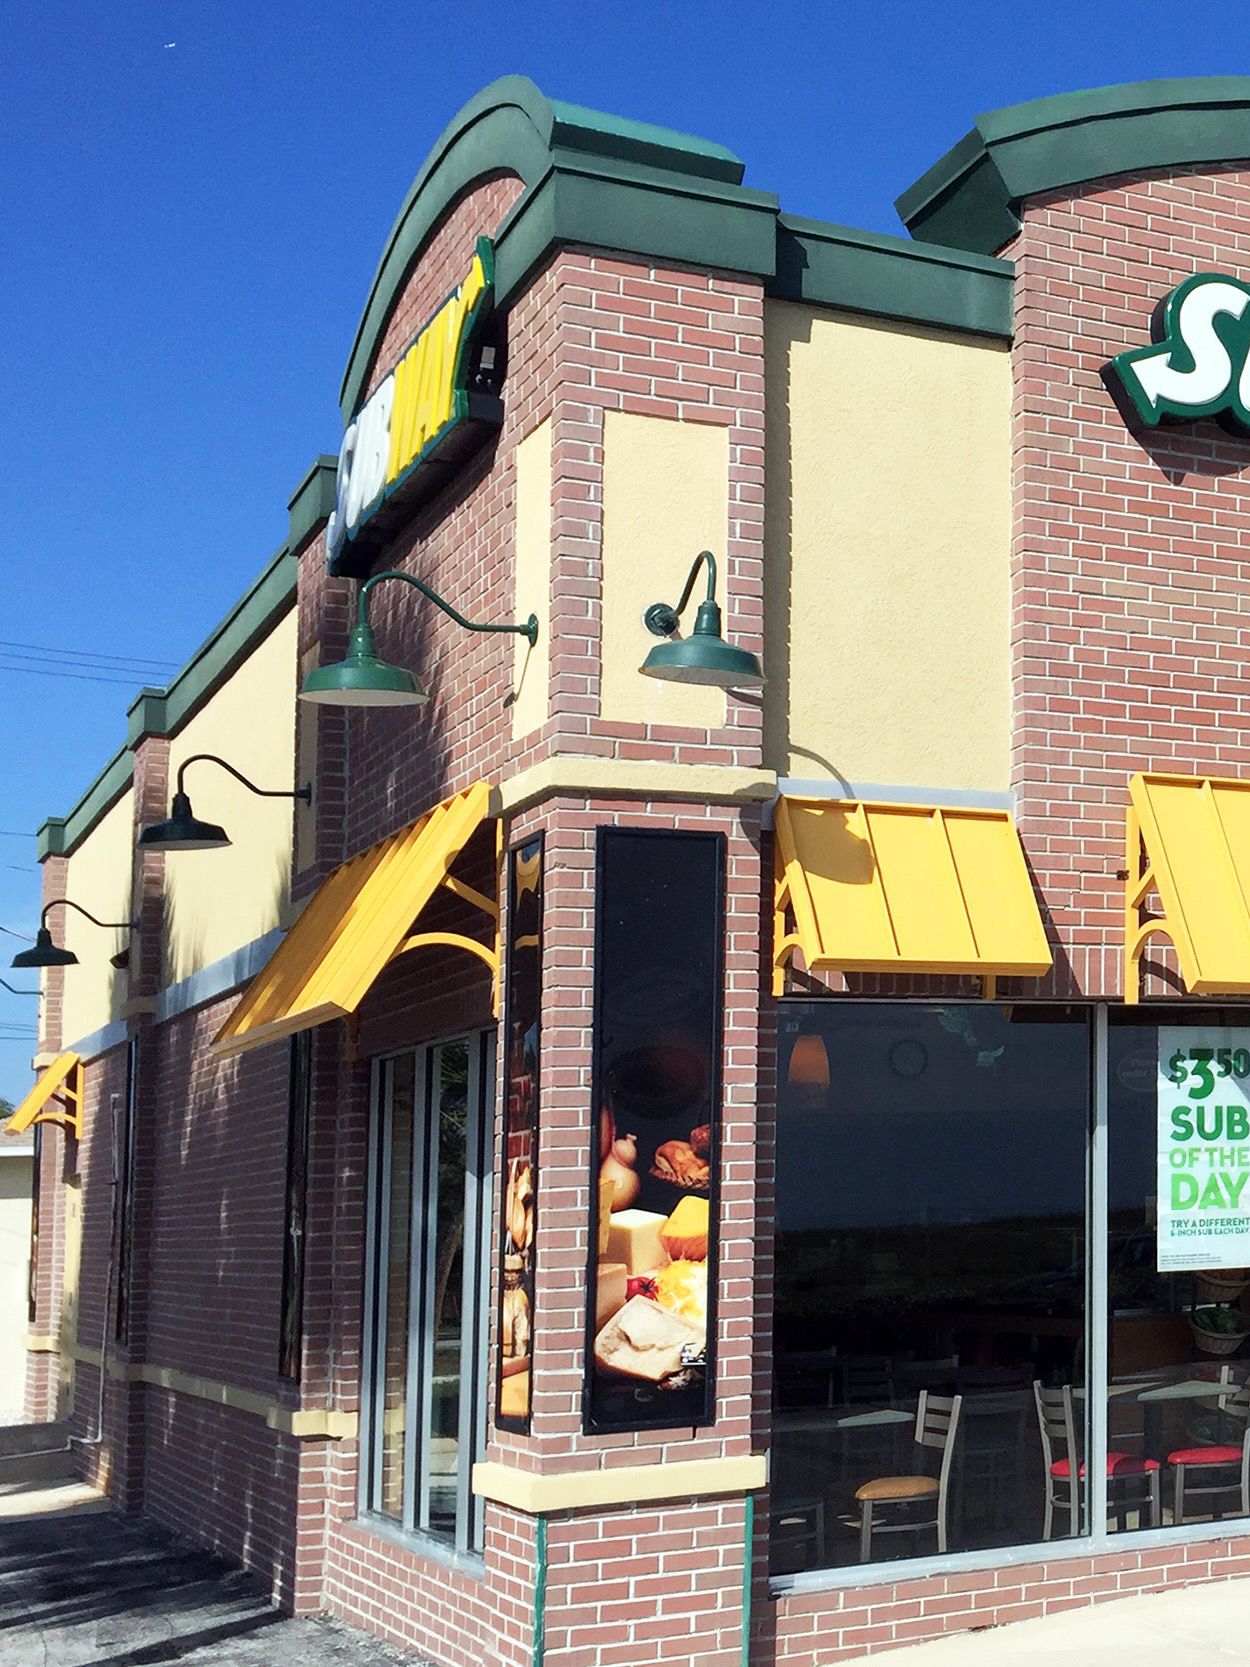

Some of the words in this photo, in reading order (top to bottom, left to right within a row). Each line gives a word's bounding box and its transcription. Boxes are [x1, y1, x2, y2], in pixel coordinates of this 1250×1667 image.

[1170, 1105, 1250, 1141] SUB
[1168, 1148, 1200, 1169] OF
[1205, 1146, 1250, 1168] THE
[1171, 1172, 1250, 1211] DAY
[1171, 1219, 1190, 1228] TRY
[1191, 1219, 1198, 1228] A
[1199, 1217, 1250, 1228] DIFFERENT
[1198, 1228, 1213, 1236] SUB
